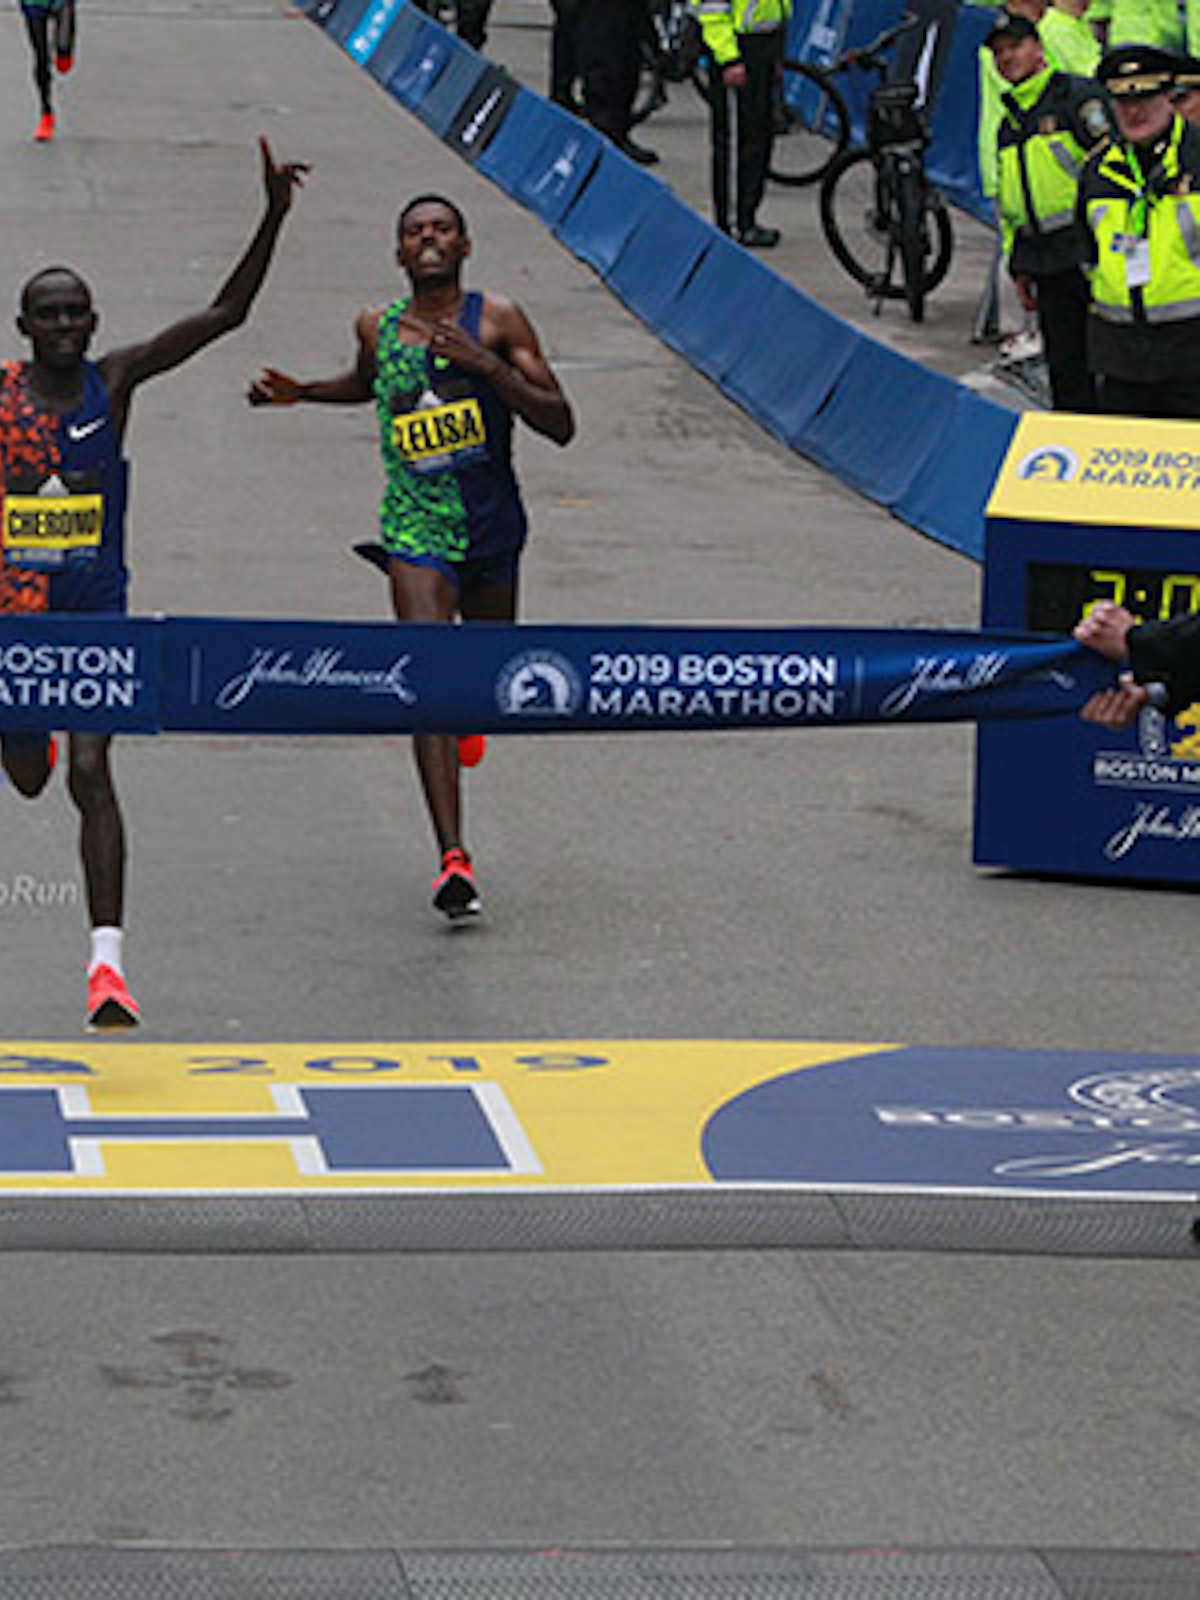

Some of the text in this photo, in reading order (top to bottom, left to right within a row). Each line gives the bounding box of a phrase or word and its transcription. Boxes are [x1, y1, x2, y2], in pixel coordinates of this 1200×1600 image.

[1090, 447, 1148, 466] 2019
[215, 648, 418, 710] John Hancock
[589, 653, 672, 685] 2019
[677, 653, 837, 687] BOSTON
[589, 687, 837, 717] MARATHON
[879, 656, 963, 717] John
[1093, 757, 1178, 783] BOSTON
[1102, 802, 1176, 862] John
[187, 1054, 610, 1075] 2019
